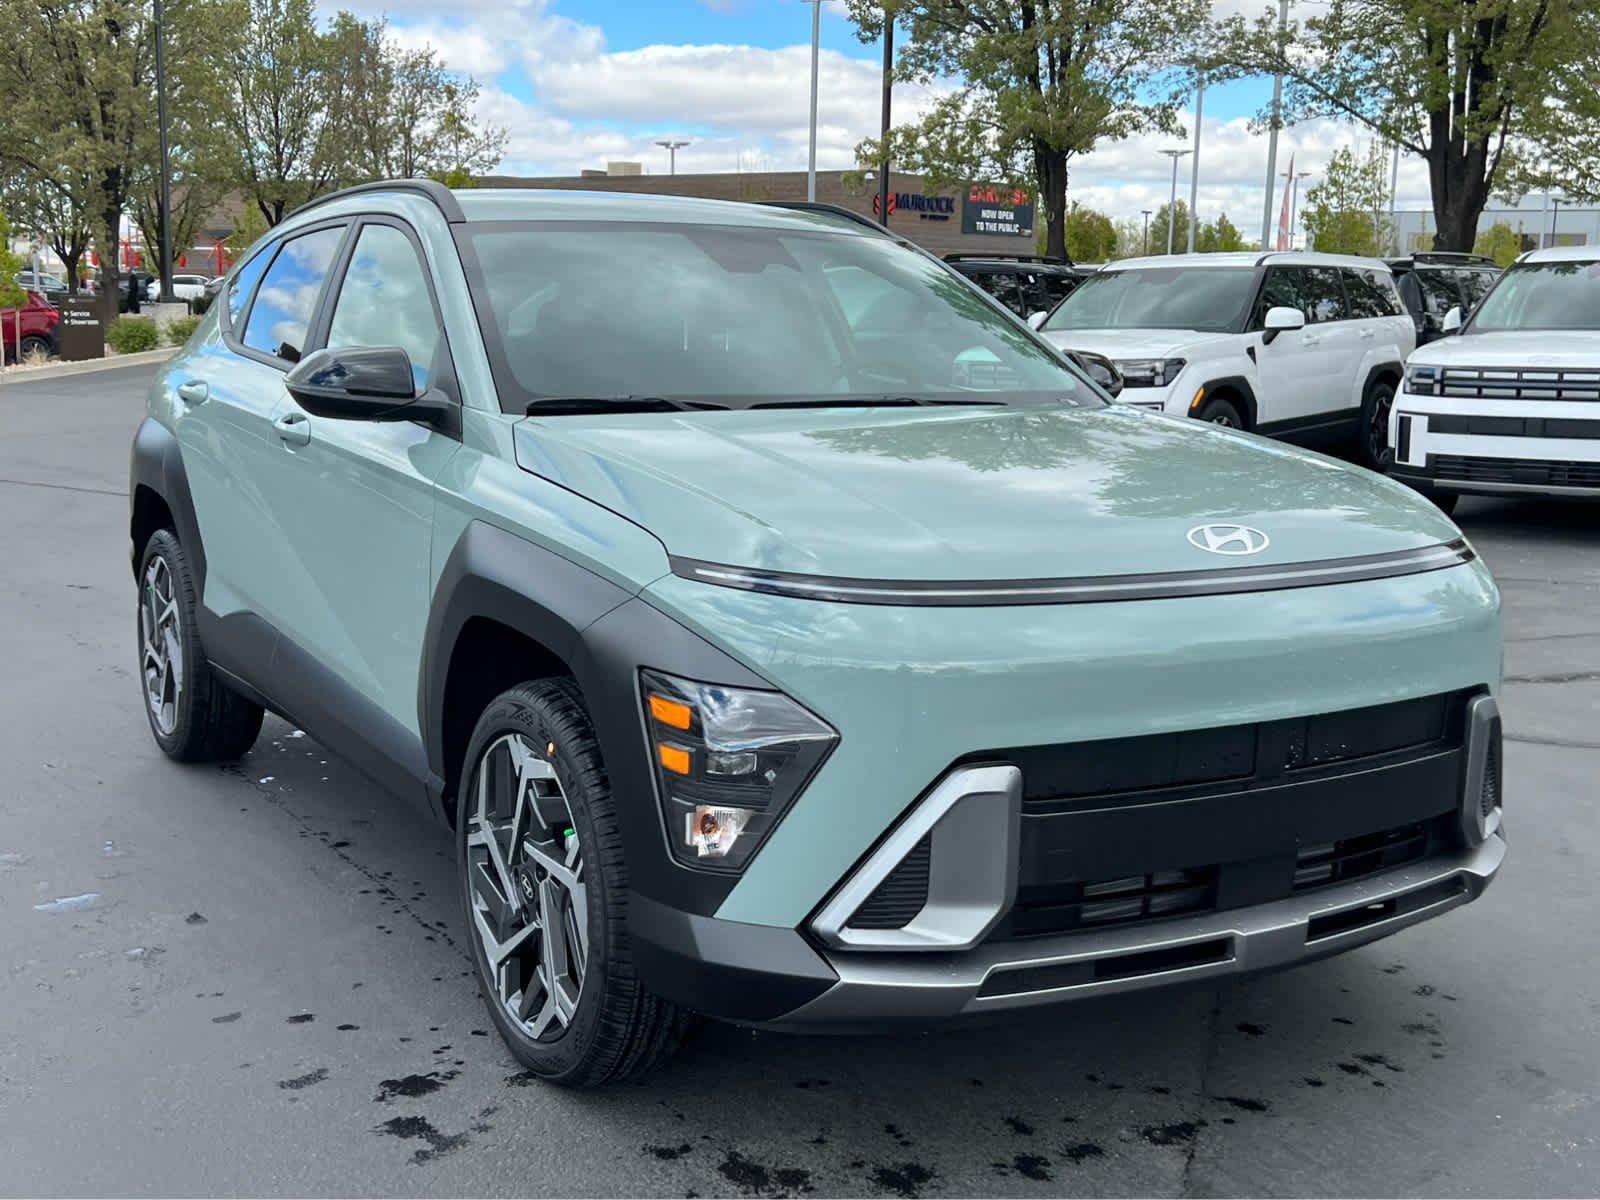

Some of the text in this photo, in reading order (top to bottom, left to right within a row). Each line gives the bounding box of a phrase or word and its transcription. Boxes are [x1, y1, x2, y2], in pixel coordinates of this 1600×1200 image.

[896, 192, 955, 213] MURDOCK
[981, 209, 1014, 220] NOW OPEN
[976, 221, 985, 231] TO
[985, 221, 997, 232] THE
[998, 222, 1020, 233] PUBLIC
